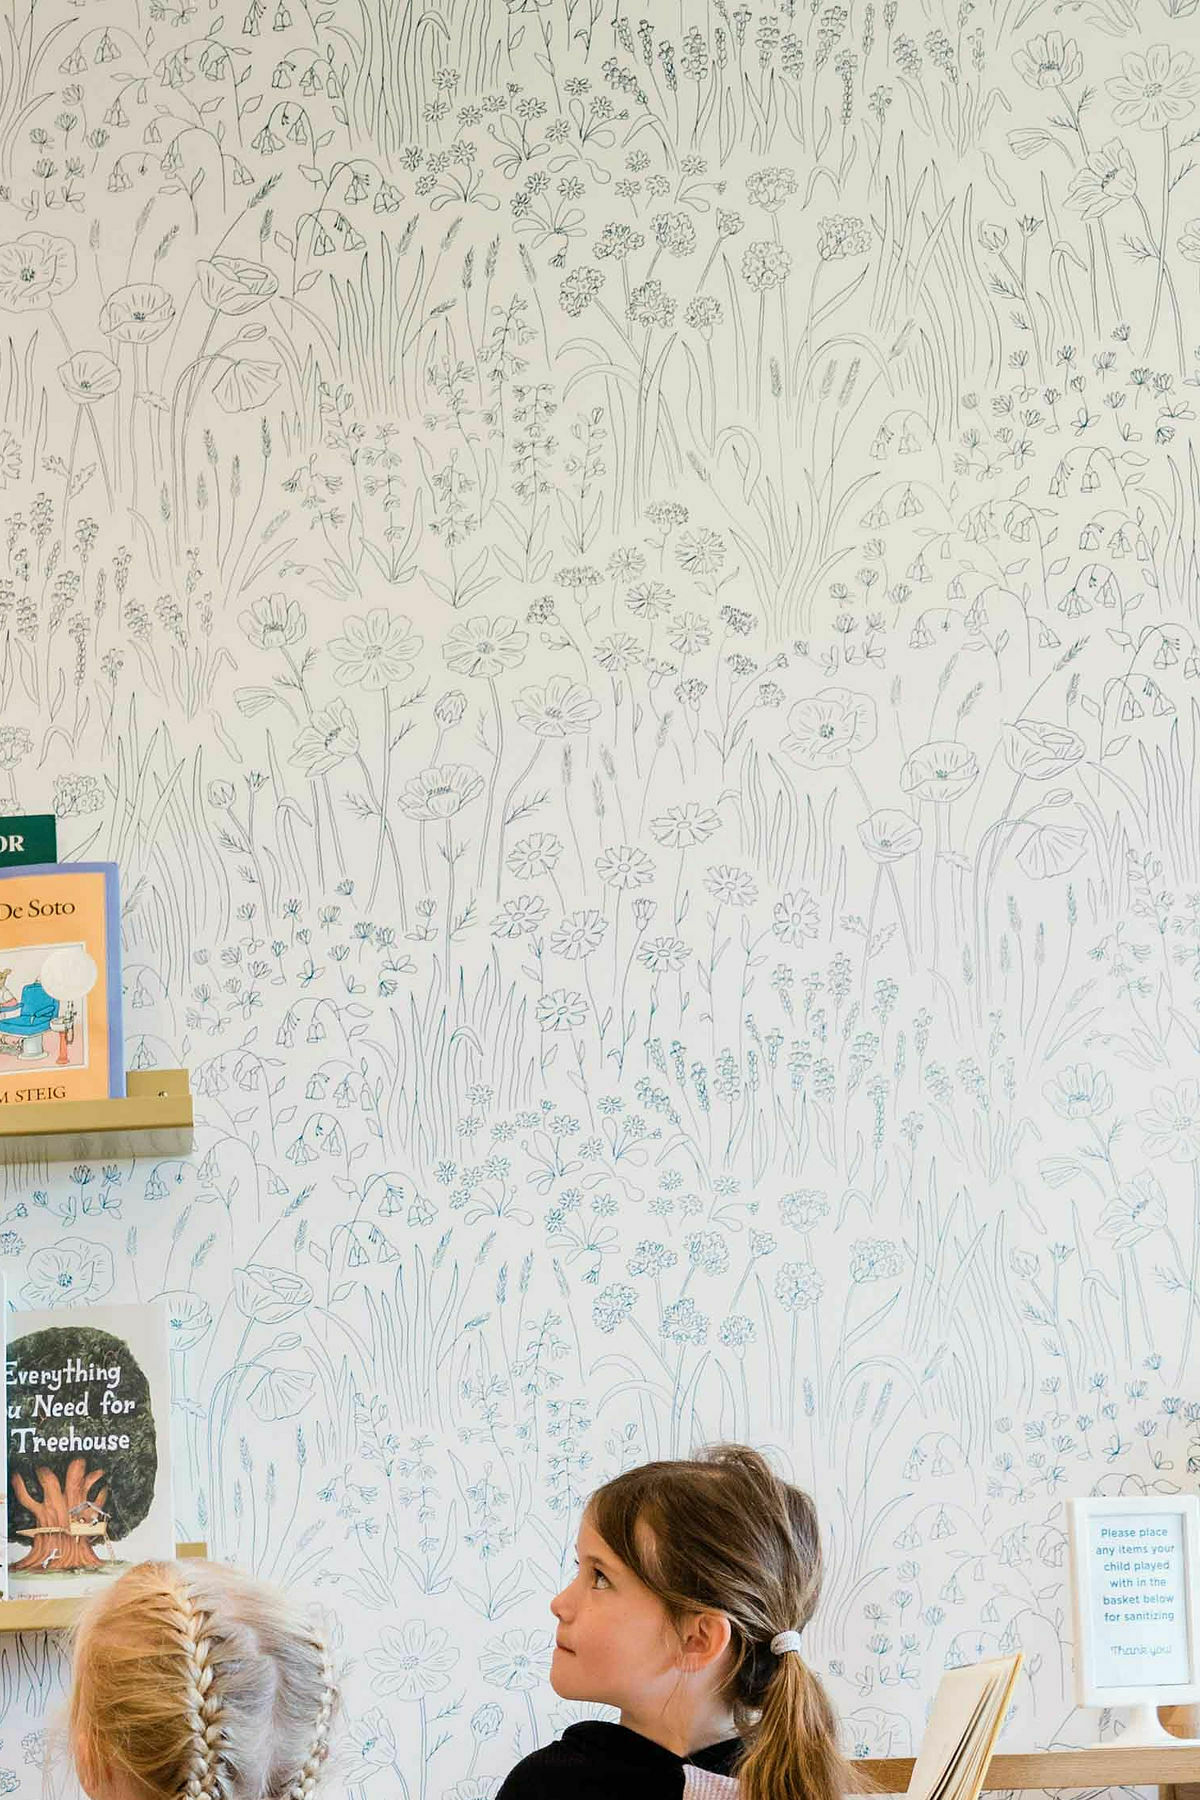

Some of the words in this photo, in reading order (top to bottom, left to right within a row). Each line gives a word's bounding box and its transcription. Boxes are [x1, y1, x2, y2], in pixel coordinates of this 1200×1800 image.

[28, 899, 76, 918] Soto
[14, 1086, 66, 1101] STEIG
[6, 1358, 121, 1391] Everything
[31, 1391, 89, 1417] Need
[99, 1390, 135, 1415] for
[11, 1425, 130, 1453] Treehouse
[1101, 1528, 1136, 1538] Please
[1139, 1528, 1168, 1539] place
[1096, 1547, 1115, 1556] any
[1119, 1545, 1148, 1554] items
[1151, 1545, 1175, 1555] your
[1104, 1562, 1131, 1572] child
[1134, 1561, 1170, 1572] played
[1110, 1578, 1134, 1588] with
[1137, 1578, 1147, 1587] in
[1150, 1578, 1167, 1587] the
[1103, 1595, 1140, 1606] basket
[1143, 1593, 1175, 1603] below
[1104, 1612, 1121, 1622] for
[1124, 1611, 1175, 1622] sanitizing
[1110, 1644, 1150, 1656] Thank
